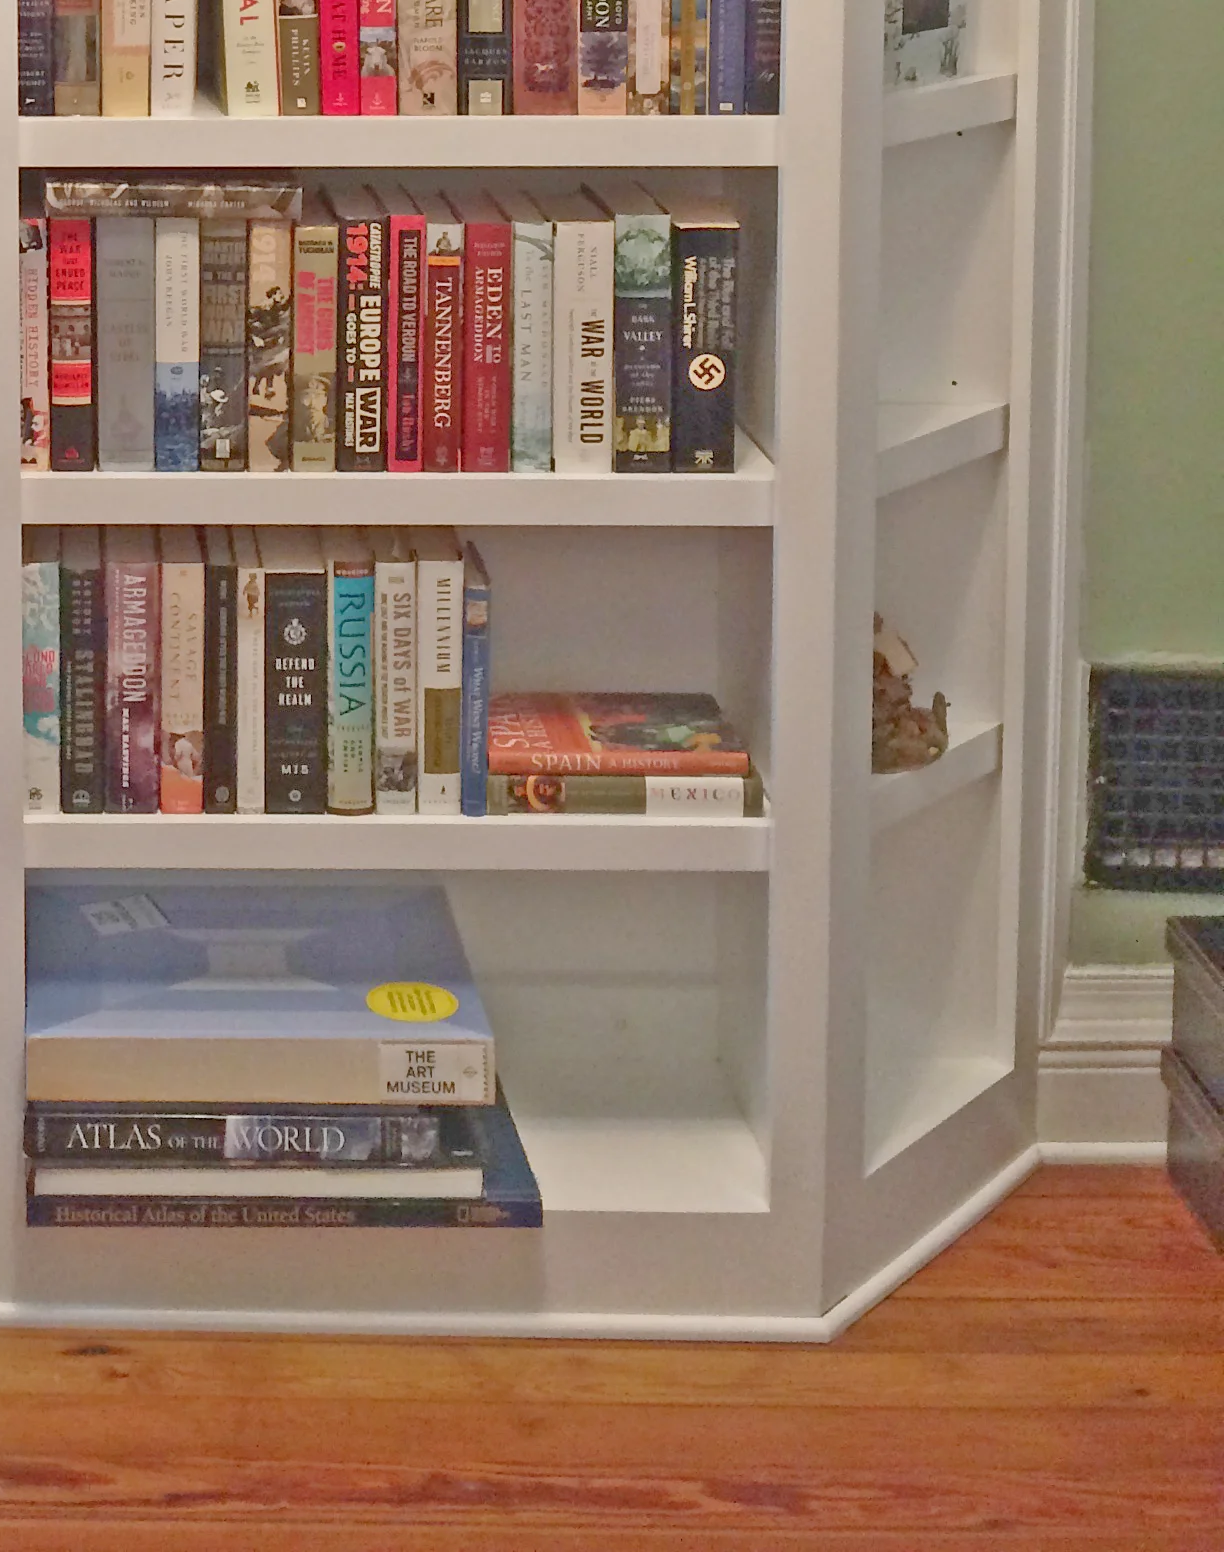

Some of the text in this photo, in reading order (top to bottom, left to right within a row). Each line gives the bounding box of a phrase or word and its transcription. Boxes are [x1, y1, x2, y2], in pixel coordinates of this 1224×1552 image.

[487, 267, 502, 337] EDEN
[359, 295, 382, 382] EUROPE
[581, 319, 605, 359] WAR
[434, 277, 452, 429] TANNENBERG
[358, 391, 375, 448] WAR
[580, 380, 605, 444] WORLD
[276, 657, 315, 671] DEFEND
[339, 592, 365, 716] RUSSIA
[393, 592, 412, 738] SIX DAYS of WAR
[285, 676, 305, 689] THE
[278, 693, 312, 706] REALM
[532, 754, 601, 769] SPAIN
[651, 787, 740, 800] MEXICO
[406, 1051, 435, 1063] THE
[406, 1066, 434, 1078] ART
[386, 1081, 456, 1095] MUSEUM
[67, 1125, 345, 1153] ATLAS OF THE WORLD
[55, 1207, 354, 1223] Historical Atlas of the United States
